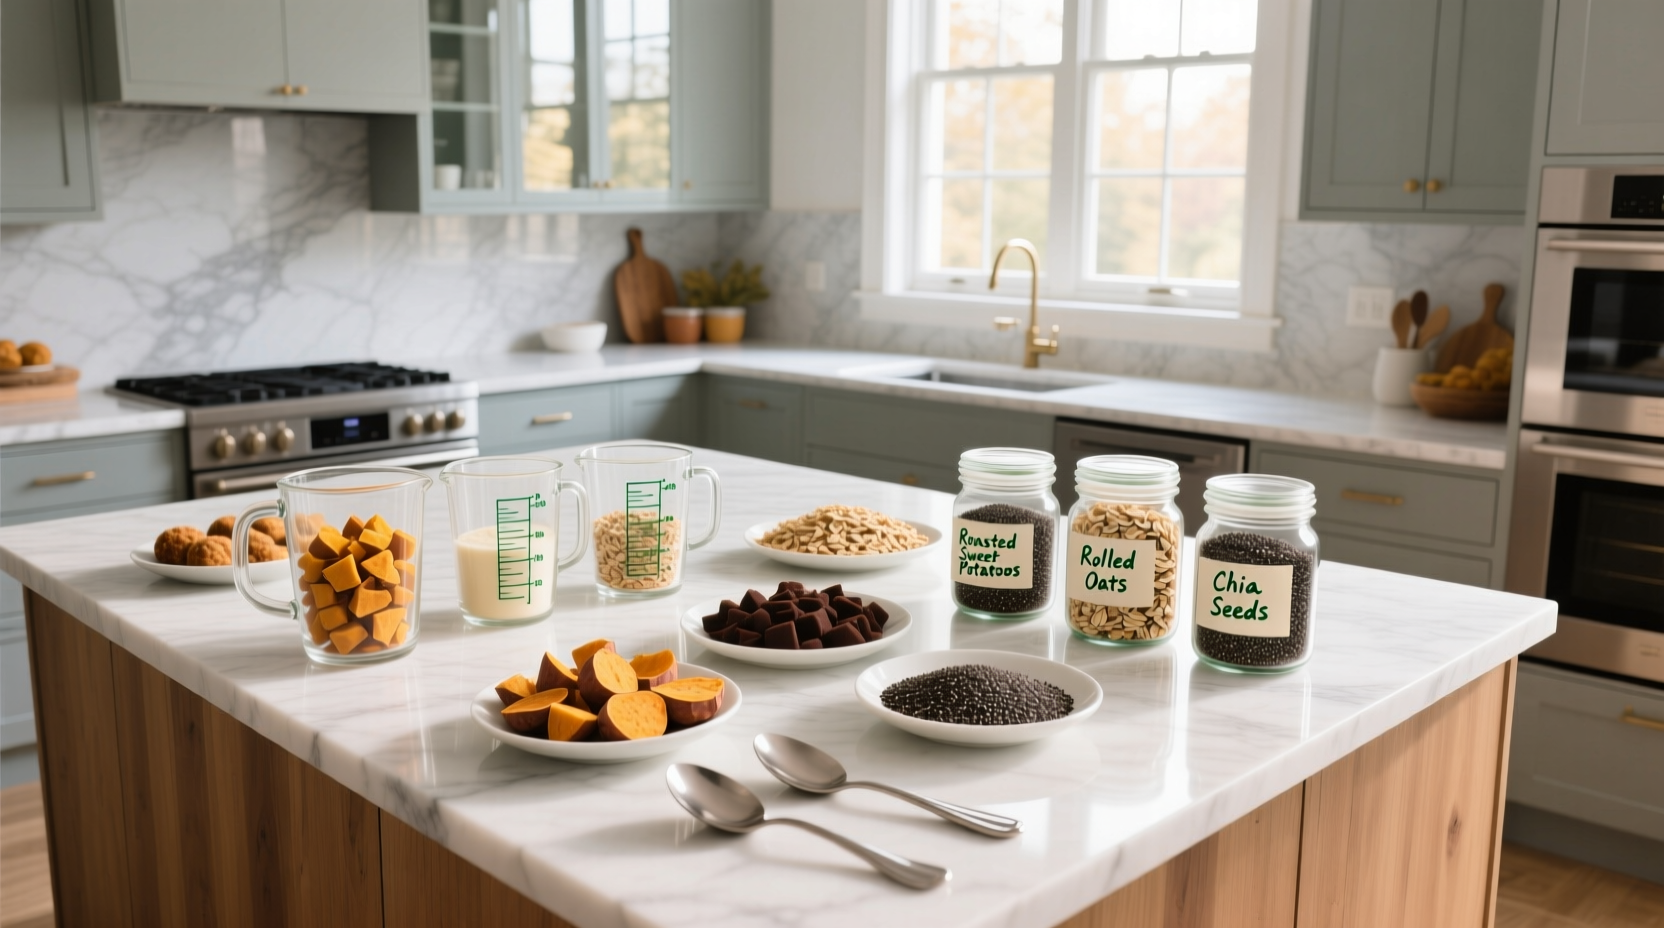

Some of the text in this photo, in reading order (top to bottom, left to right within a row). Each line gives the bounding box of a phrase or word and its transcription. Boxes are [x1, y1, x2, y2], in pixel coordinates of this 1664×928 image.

[959, 546, 1000, 562] Sweet
[1080, 545, 1136, 570] Rolled
[1085, 571, 1127, 593] Oats
[1213, 570, 1263, 595] Chia
[1210, 596, 1269, 621] Seeds
